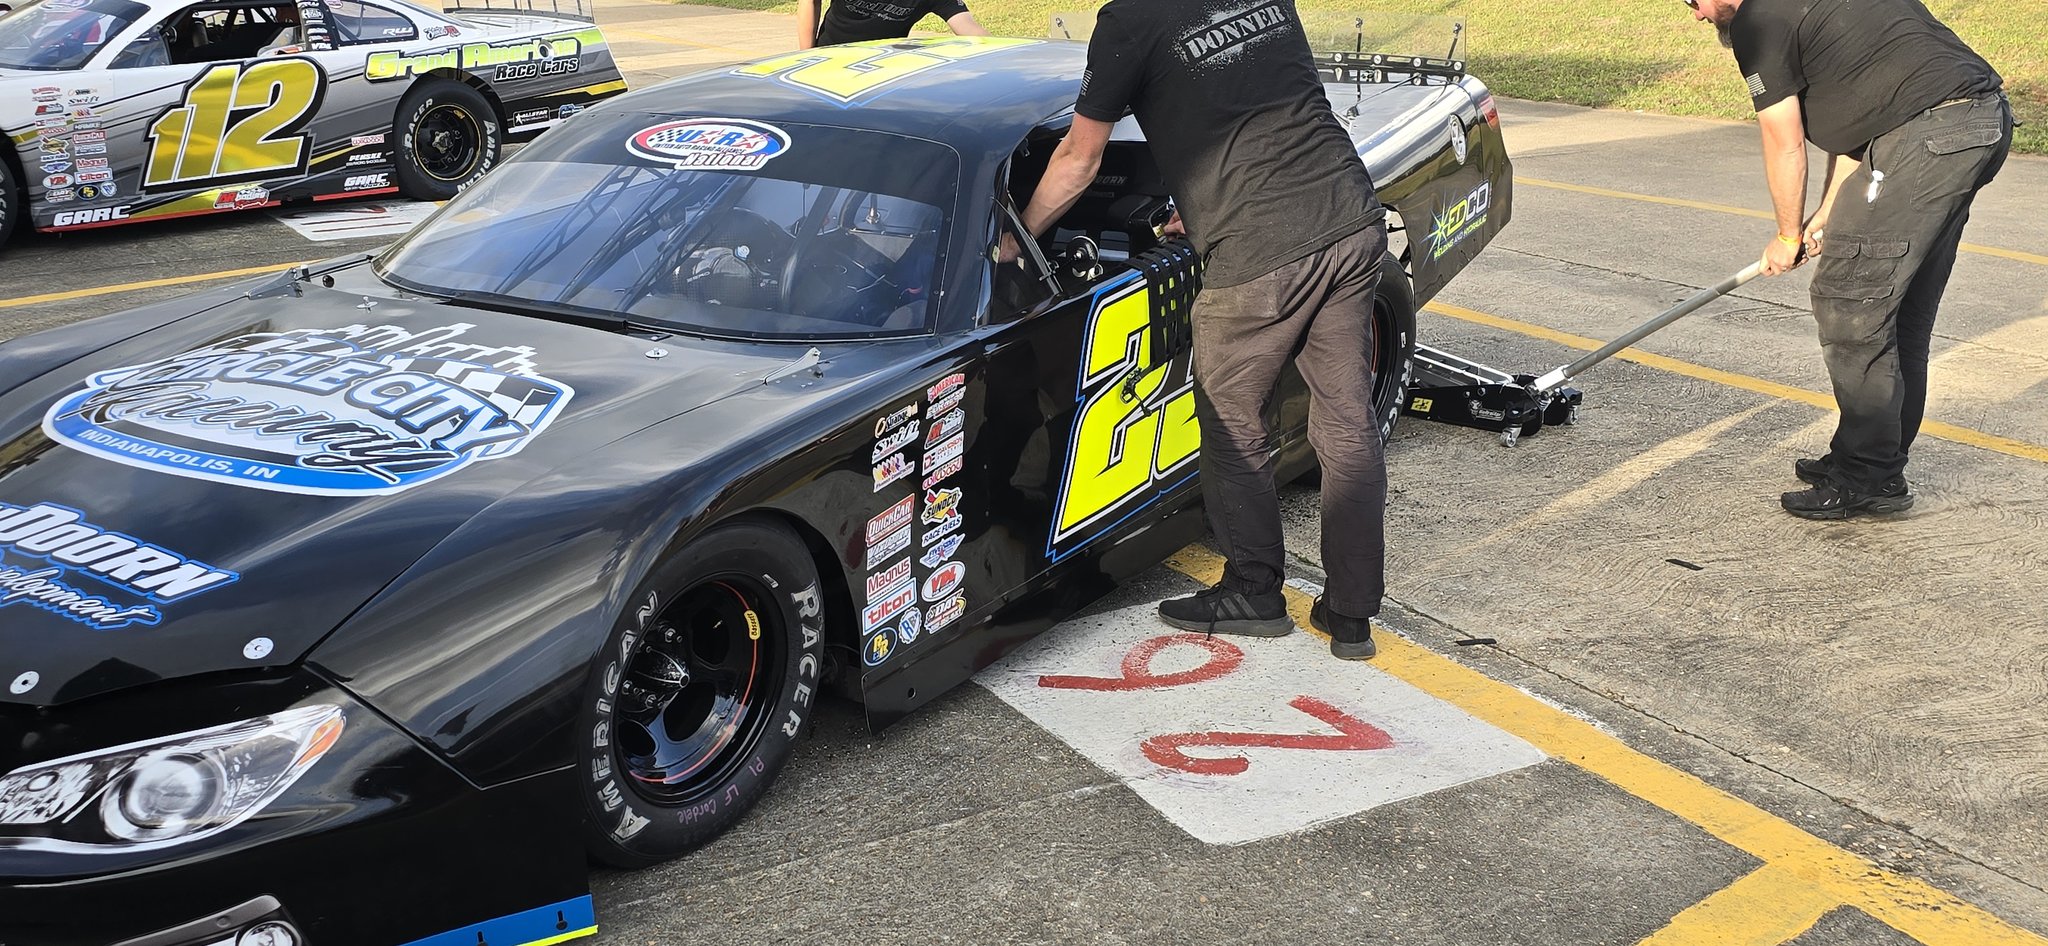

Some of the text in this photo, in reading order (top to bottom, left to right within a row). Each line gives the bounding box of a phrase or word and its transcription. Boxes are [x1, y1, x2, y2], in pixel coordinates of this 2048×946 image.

[1185, 4, 1286, 59] DONNER
[367, 48, 460, 80] Grand
[495, 57, 580, 82] Race Cars
[680, 152, 768, 167] National
[344, 172, 389, 187] GARC
[53, 204, 131, 226] GARC
[118, 350, 530, 452] CIRCLE CITY
[873, 421, 919, 455] Swift
[77, 430, 282, 480] INDIANAPOLIS, IN
[926, 494, 959, 519] SUNOCO
[924, 528, 942, 545] RACE
[942, 518, 961, 534] FUELS
[867, 559, 910, 593] Magnus
[868, 589, 912, 624] tilton
[782, 580, 823, 743] RACER
[590, 589, 661, 843] AMERICAN
[725, 783, 740, 807] LF
[677, 798, 718, 825] Cordele
